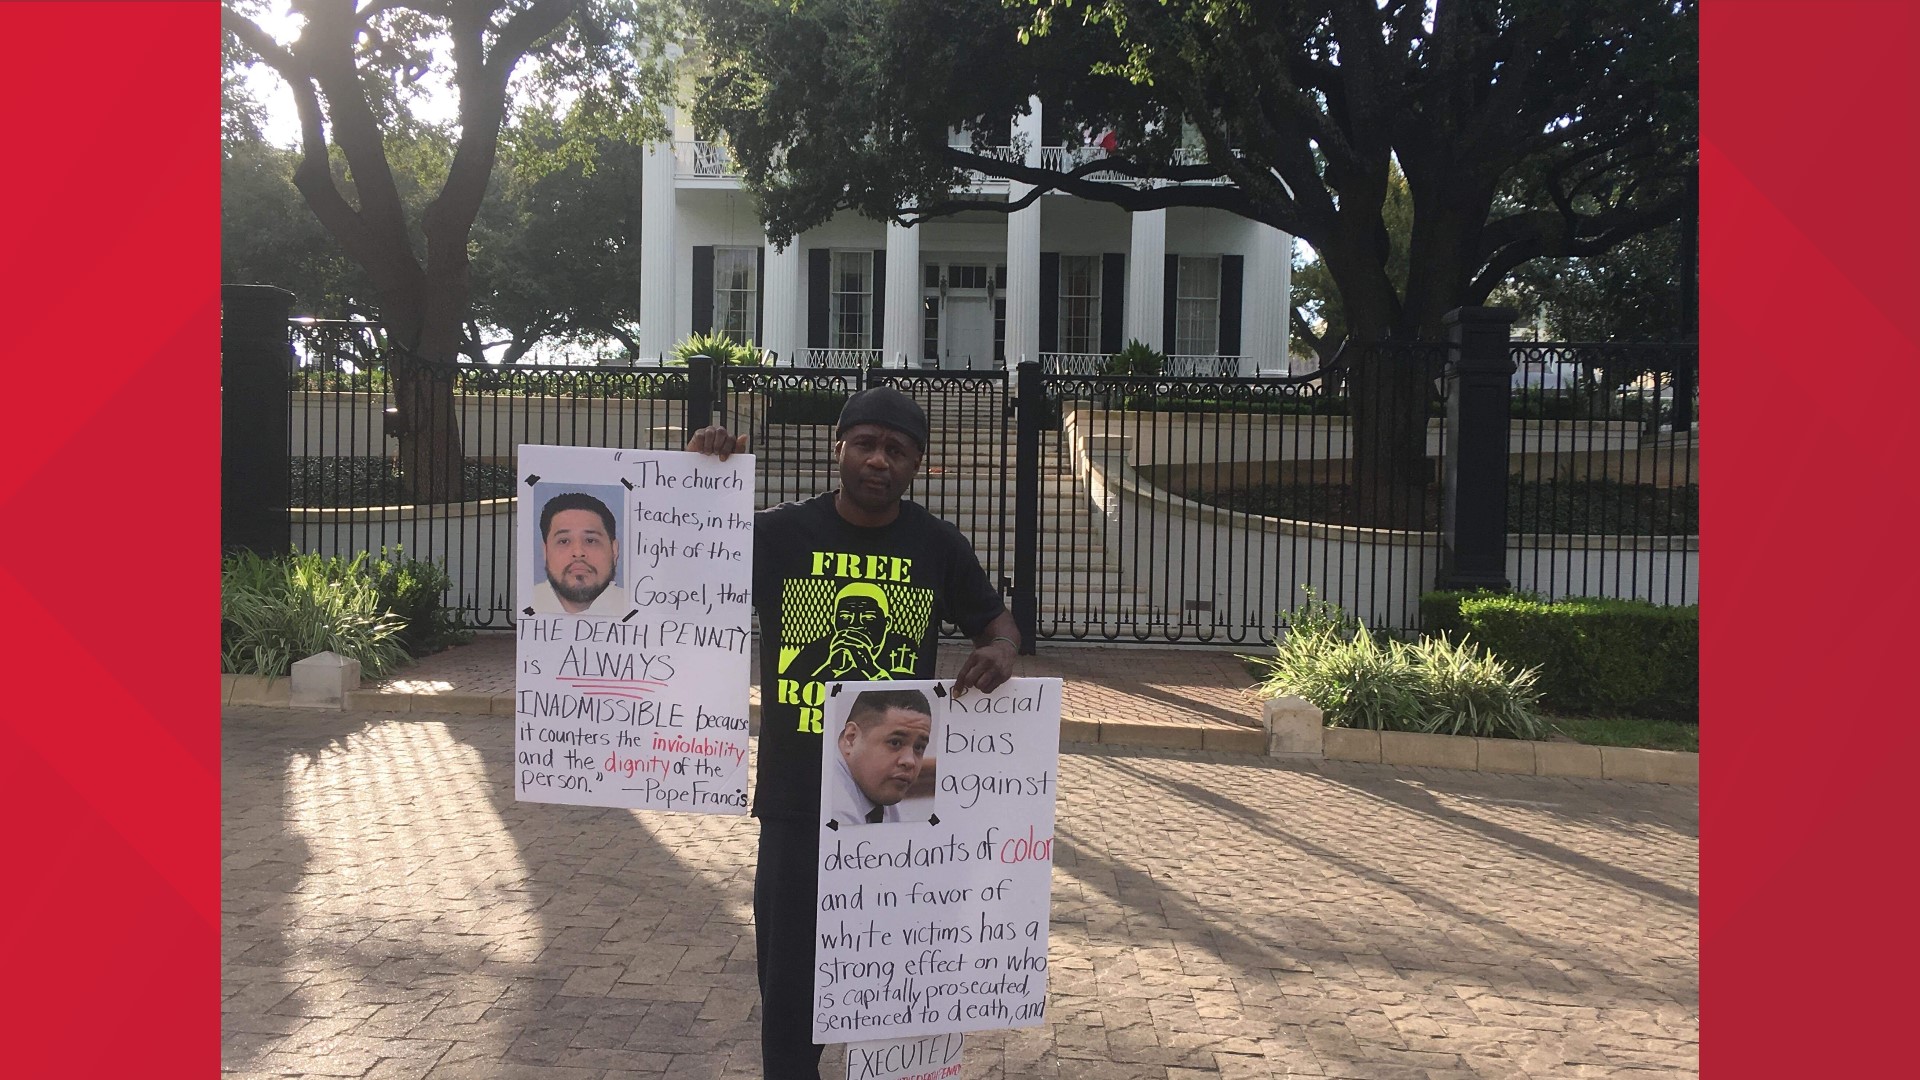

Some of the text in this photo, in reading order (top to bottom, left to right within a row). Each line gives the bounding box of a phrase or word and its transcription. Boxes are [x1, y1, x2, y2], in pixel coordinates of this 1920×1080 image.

[682, 468, 743, 491] church
[634, 502, 752, 531] teaches, in the
[637, 531, 741, 568] light of the
[810, 551, 912, 583] FREE
[634, 575, 751, 615] Gospel, that
[517, 618, 750, 654] THE DEATH PENALTY
[524, 645, 675, 681] is ALWAYS
[517, 690, 749, 732] INADMISSIBLE because
[949, 684, 1044, 714] Racial
[520, 721, 746, 767] it counters the inviolability
[945, 724, 1014, 755] bias
[519, 748, 724, 782] and the dignity of the
[691, 780, 748, 807] Francis
[941, 771, 1055, 809] against
[824, 825, 1054, 871] defendants of color
[821, 878, 1012, 911] and in favor of
[821, 911, 1039, 952] white victims has a
[819, 946, 1047, 988] strong effect on who
[818, 973, 1031, 1010] is capitally prosecuted,
[918, 1005, 939, 1024] to
[947, 999, 1014, 1025] death,
[1015, 995, 1047, 1020] and
[847, 1031, 963, 1080] EXECUTED
